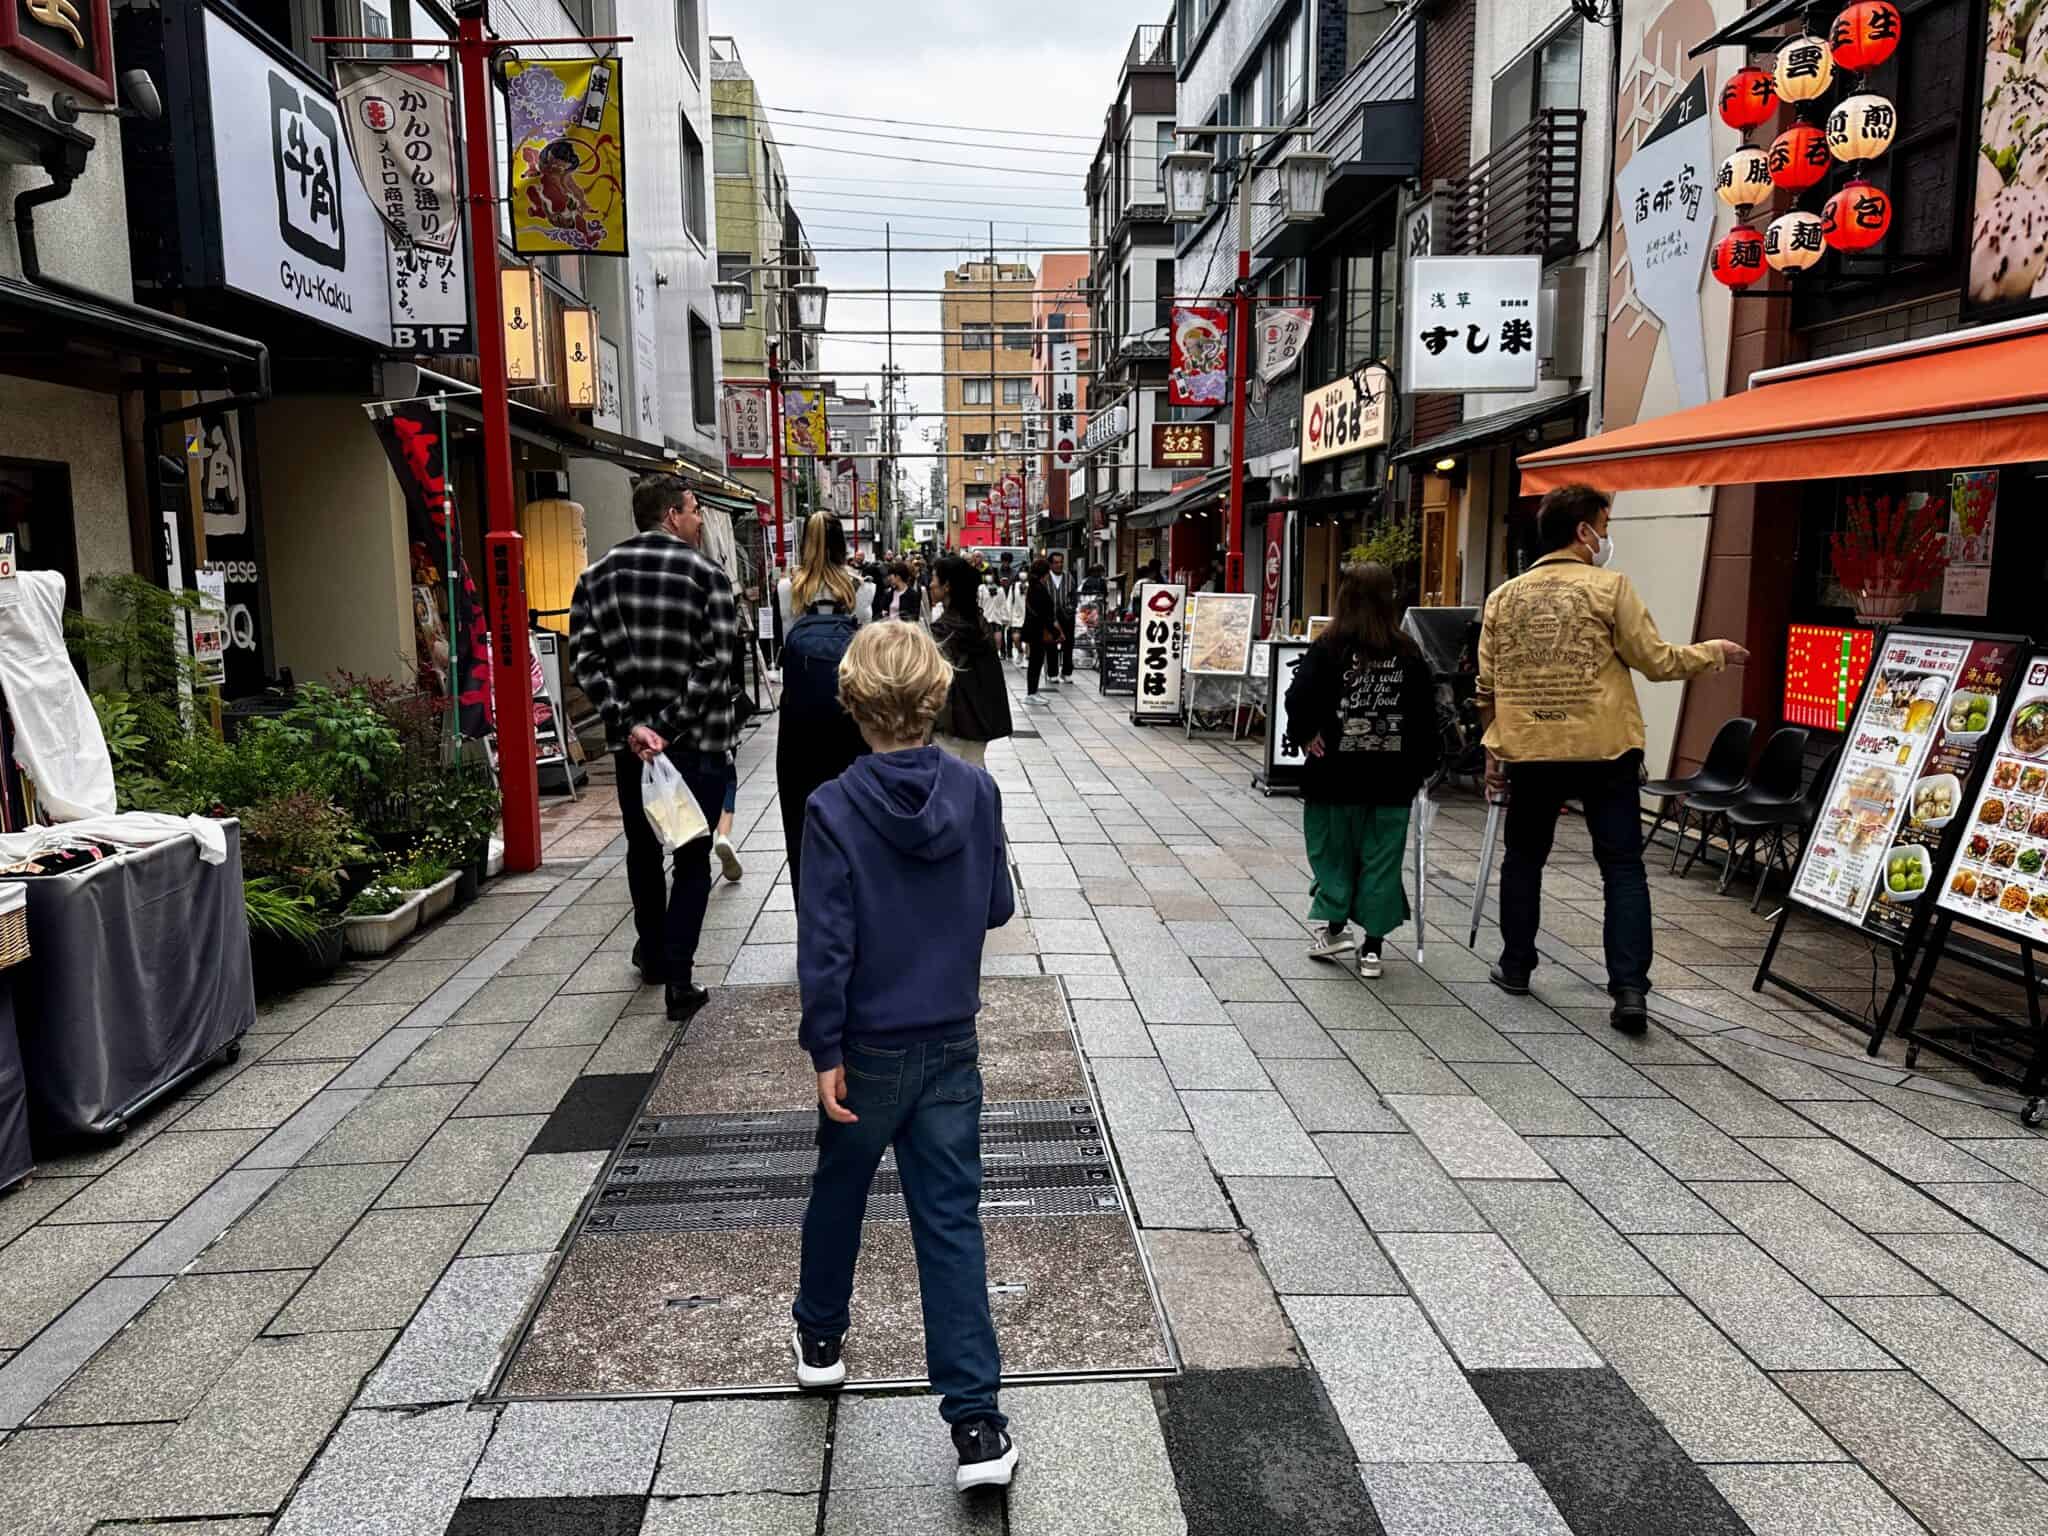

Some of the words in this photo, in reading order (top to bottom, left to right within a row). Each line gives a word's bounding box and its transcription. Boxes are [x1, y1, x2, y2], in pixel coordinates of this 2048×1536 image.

[1868, 5, 1898, 40] 生
[1786, 45, 1823, 79] 雲
[1752, 77, 1778, 105] 牛
[1677, 97, 1695, 125] 2F
[1862, 104, 1895, 139] 煎
[284, 114, 338, 234] 牛角
[399, 87, 440, 233] かんのん通り
[1853, 195, 1886, 229] 包
[280, 259, 353, 314] Gyu-Kaku
[1431, 292, 1472, 309] 浅草
[393, 327, 465, 349] B1F
[1420, 317, 1534, 356] すし栄
[1323, 401, 1362, 448] いろは
[1144, 620, 1170, 697] いろは
